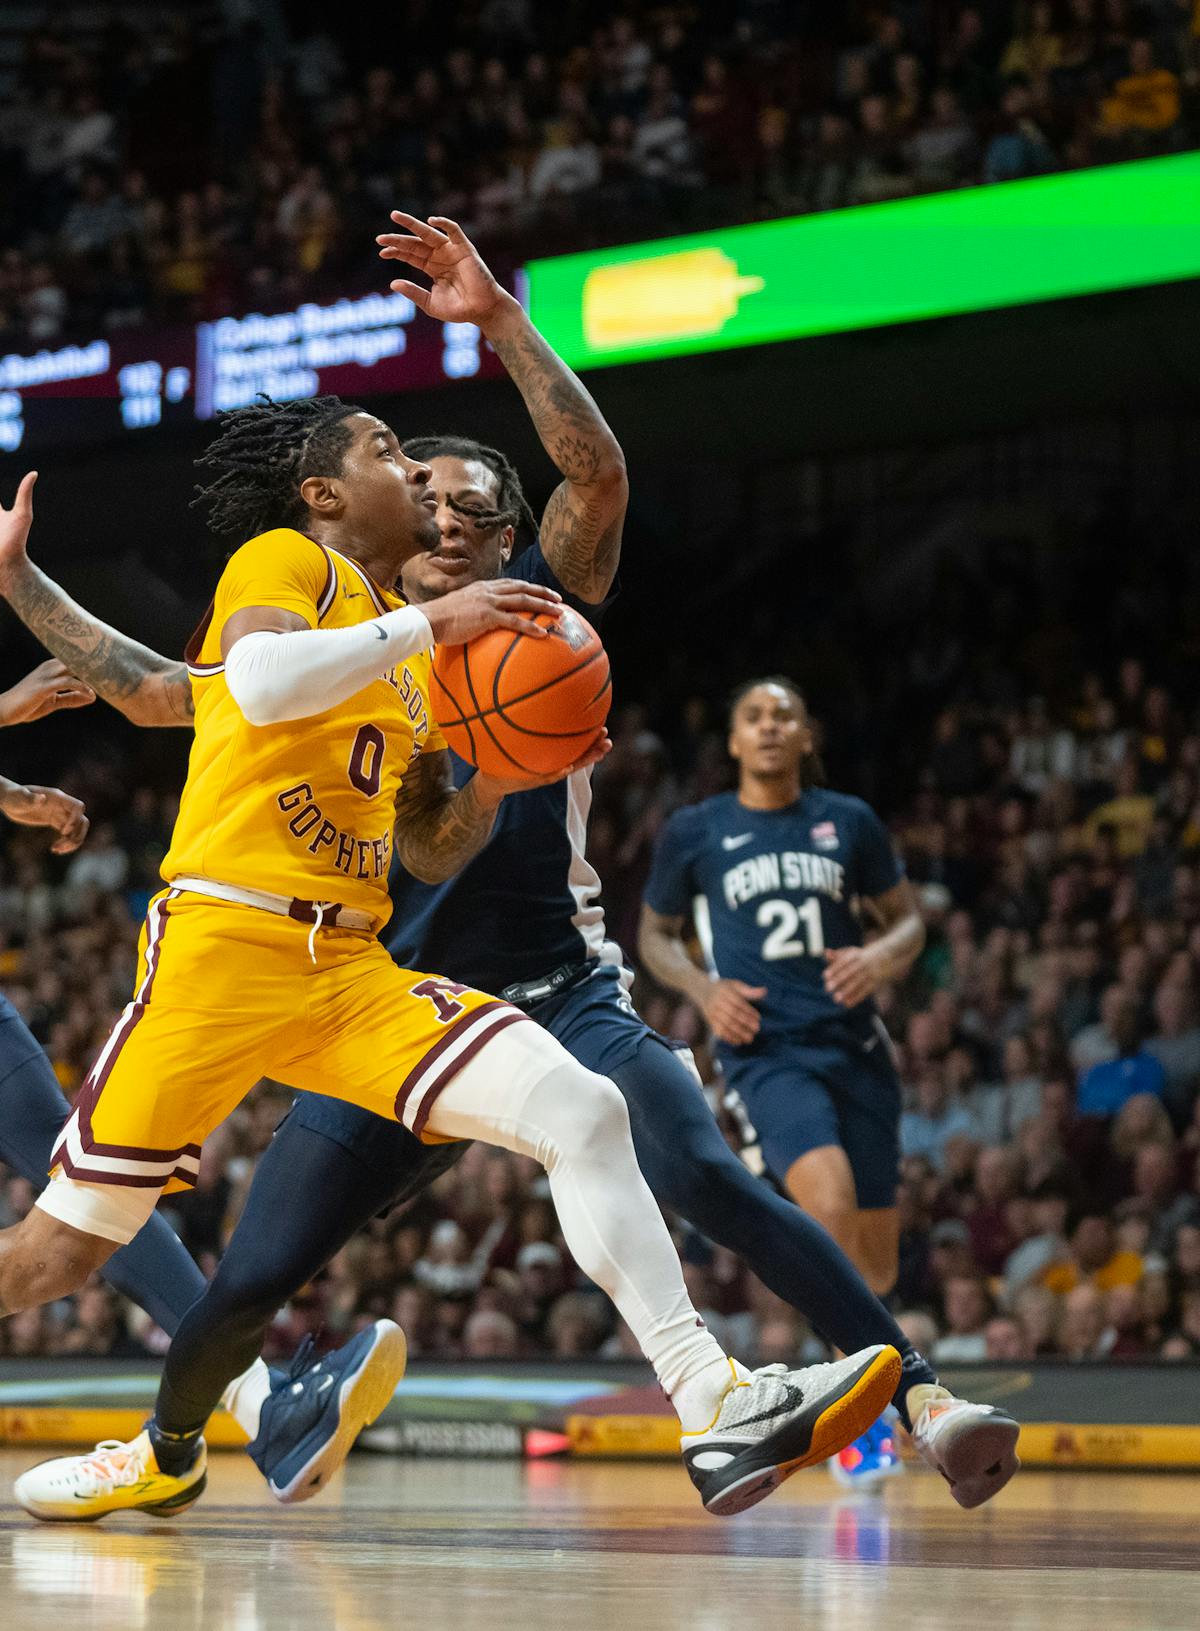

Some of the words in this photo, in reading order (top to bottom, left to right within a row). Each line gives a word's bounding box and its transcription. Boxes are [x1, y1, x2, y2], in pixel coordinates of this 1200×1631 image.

[347, 722, 387, 799] 0
[722, 852, 782, 912] PENN
[780, 851, 846, 904] STATE
[755, 896, 826, 962] 21
